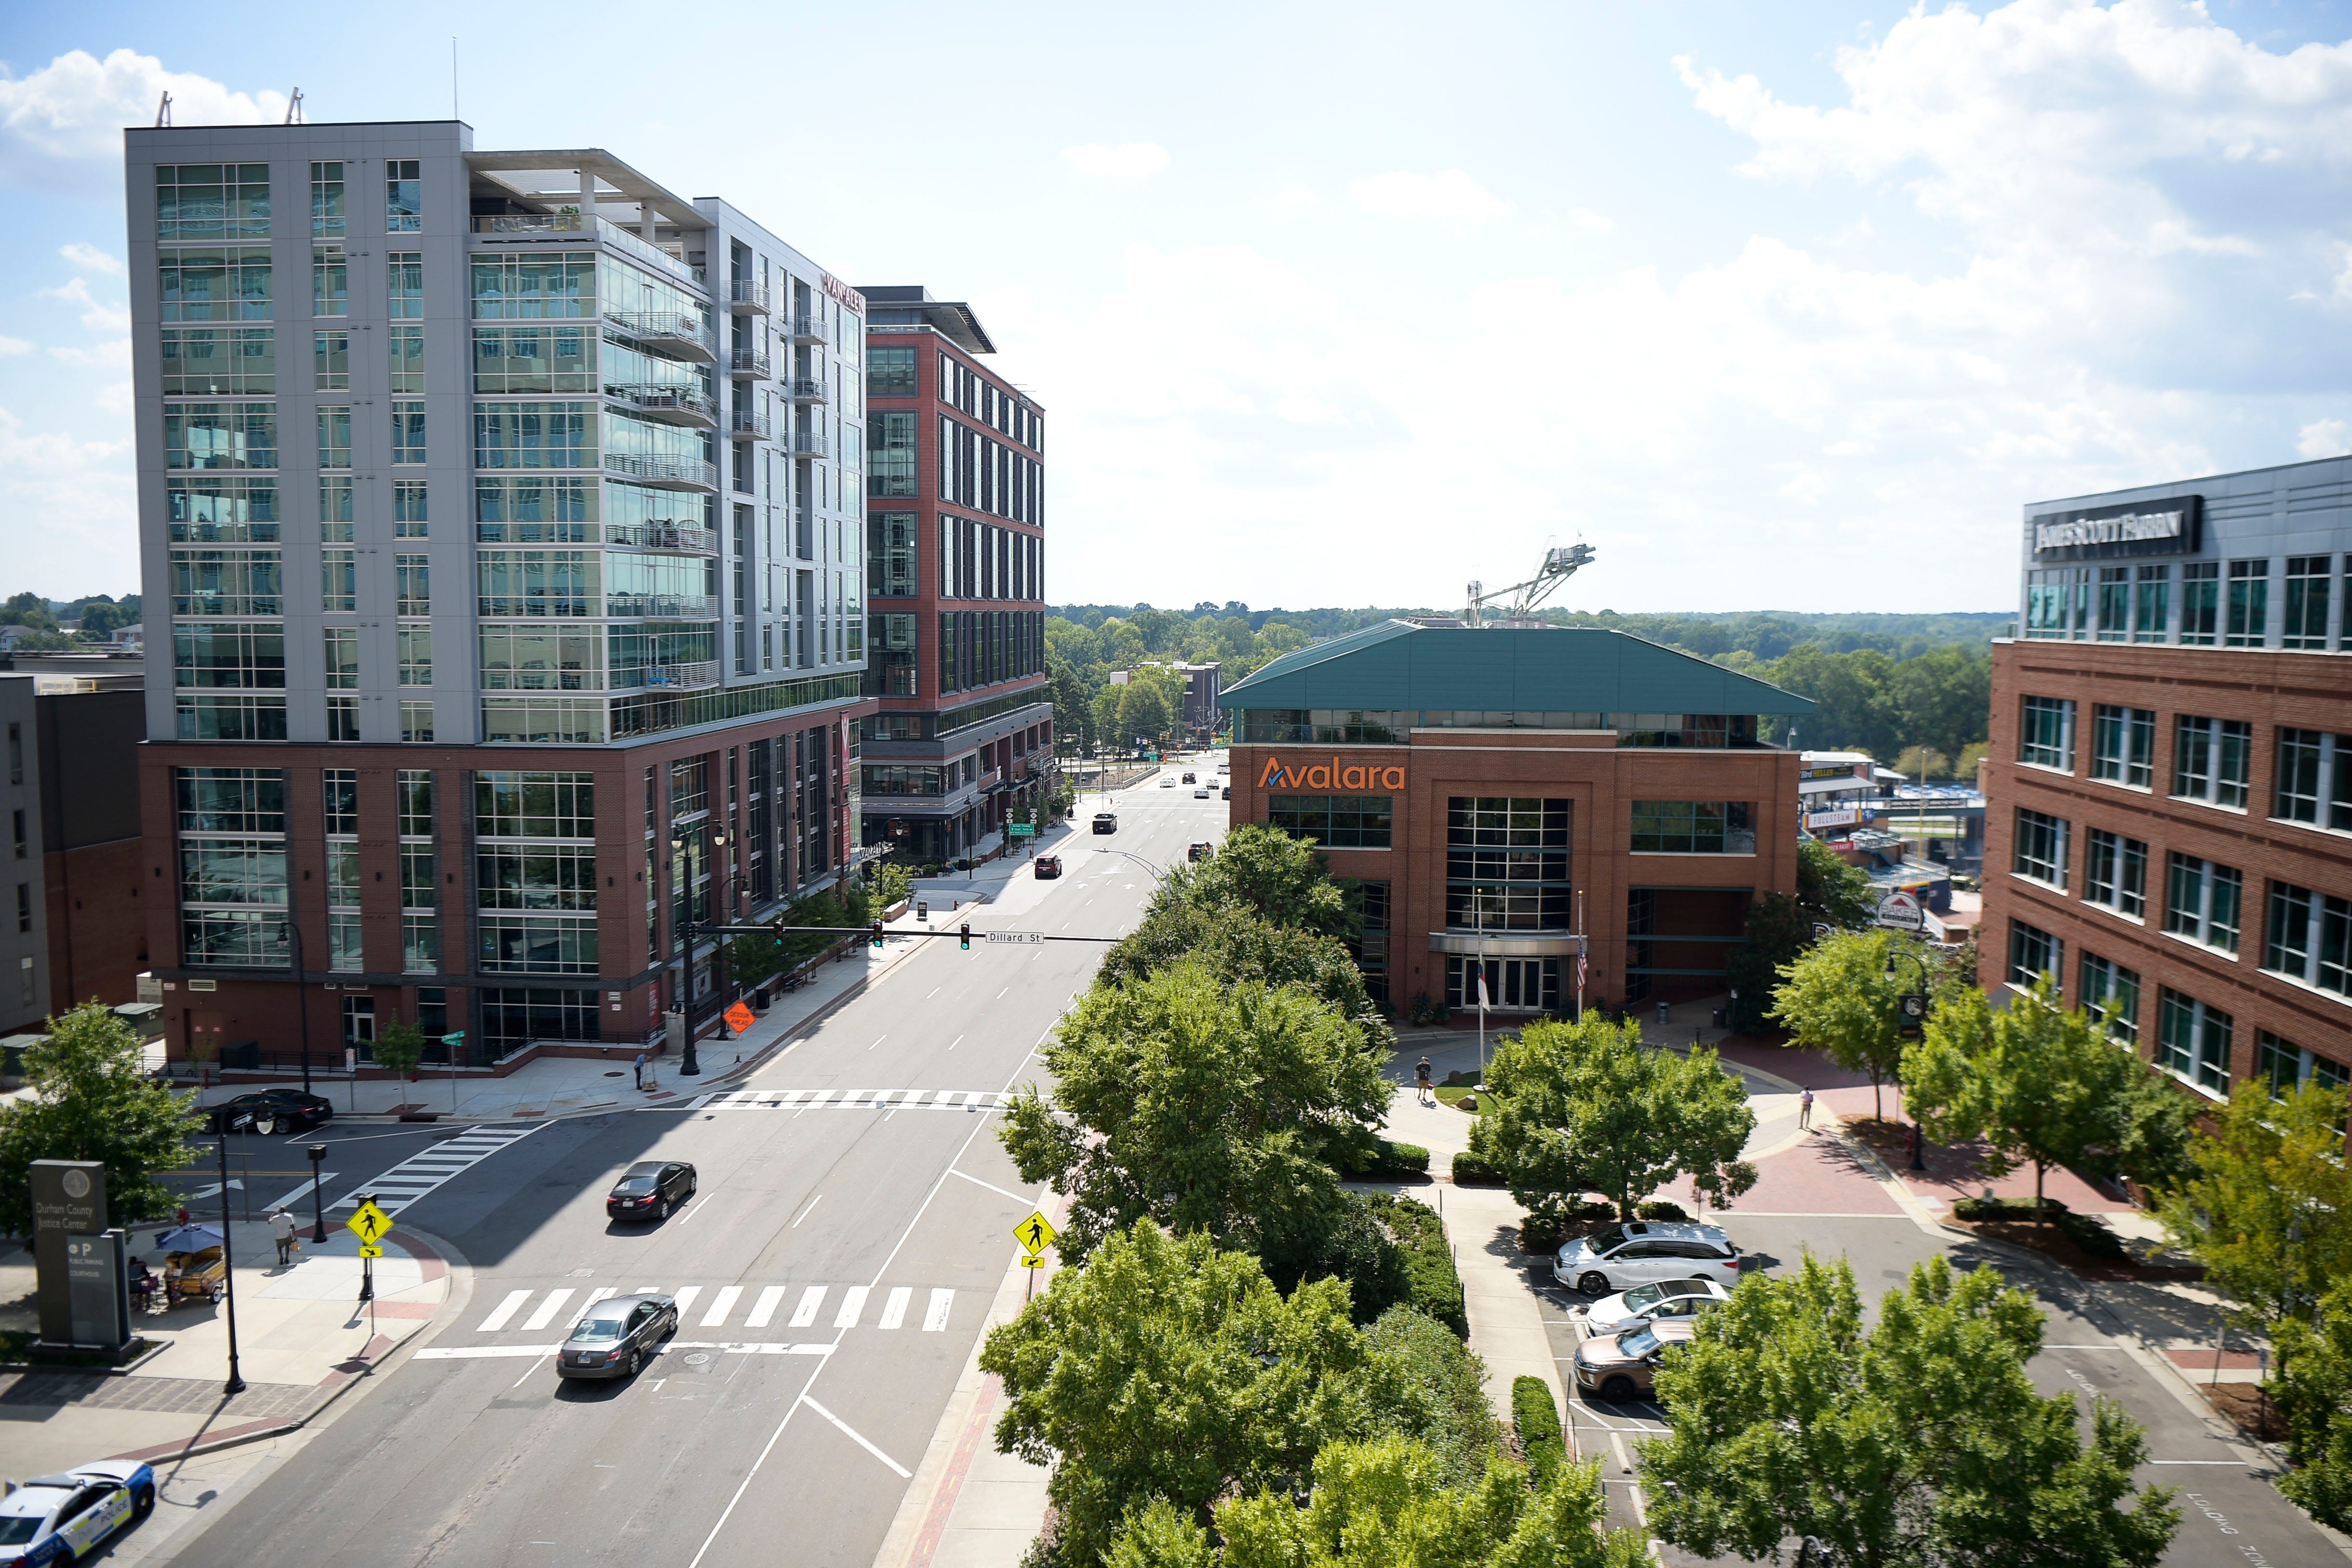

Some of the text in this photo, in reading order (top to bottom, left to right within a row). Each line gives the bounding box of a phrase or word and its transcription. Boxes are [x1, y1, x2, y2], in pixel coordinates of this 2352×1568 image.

[825, 273, 843, 301] VAN
[1257, 756, 1405, 790] Avalara
[1814, 813, 1850, 825] FULLSTEAM
[1881, 904, 1918, 919] BAKER
[990, 933, 1022, 941] Dillard
[36, 1203, 93, 1218] Durham County
[38, 1217, 87, 1230] Justice Center
[82, 1243, 92, 1256] P
[100, 1500, 128, 1525] POLICE
[2185, 1493, 2240, 1535] LOADING
